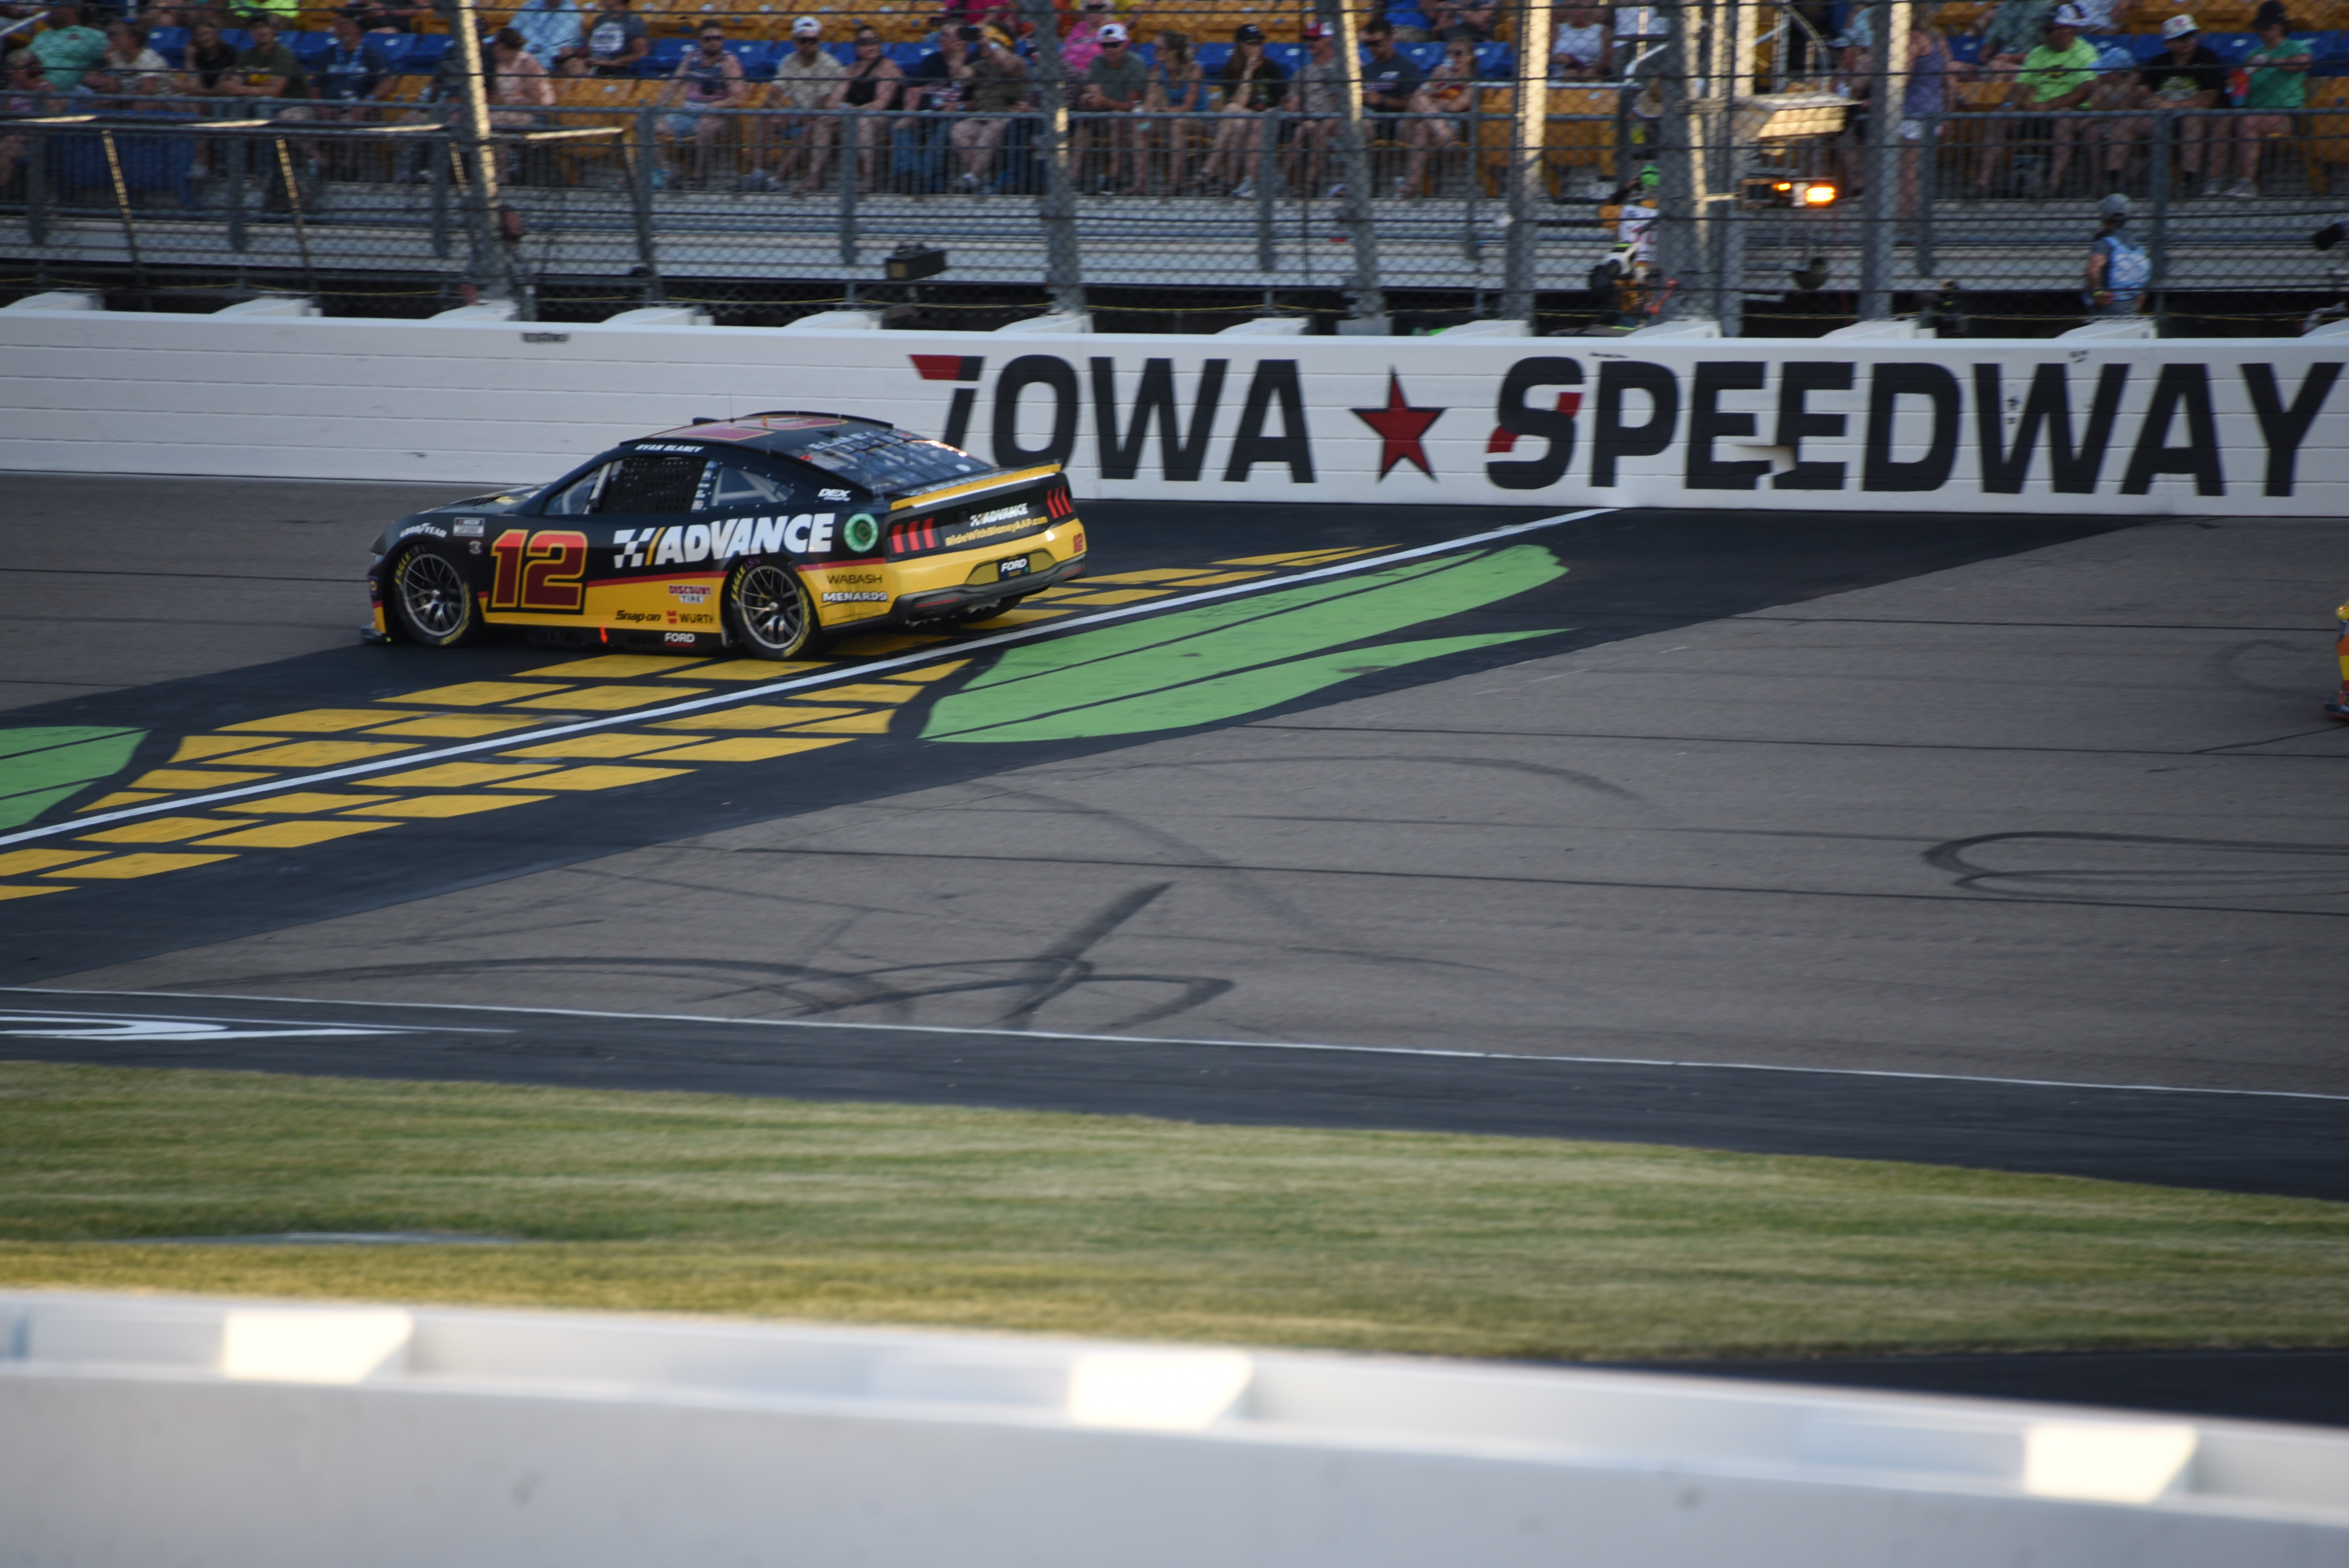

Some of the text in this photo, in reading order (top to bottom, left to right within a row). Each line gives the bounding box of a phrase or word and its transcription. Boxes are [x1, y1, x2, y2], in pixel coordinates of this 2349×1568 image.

[1485, 356, 2347, 497] SPEEDWAY
[818, 488, 852, 497] DEX
[983, 503, 1028, 524] ADVANCE
[399, 522, 447, 538] GOODYEAR
[654, 513, 836, 565] ADVANCE
[490, 529, 588, 610] 12
[1000, 558, 1027, 573] FORD
[731, 565, 746, 601] EAGLE
[826, 574, 883, 584] WABASH
[668, 584, 711, 596] DISCOUNT
[822, 591, 888, 602] MENARDS
[615, 610, 661, 623] Snap-on
[664, 632, 695, 643] FORD
